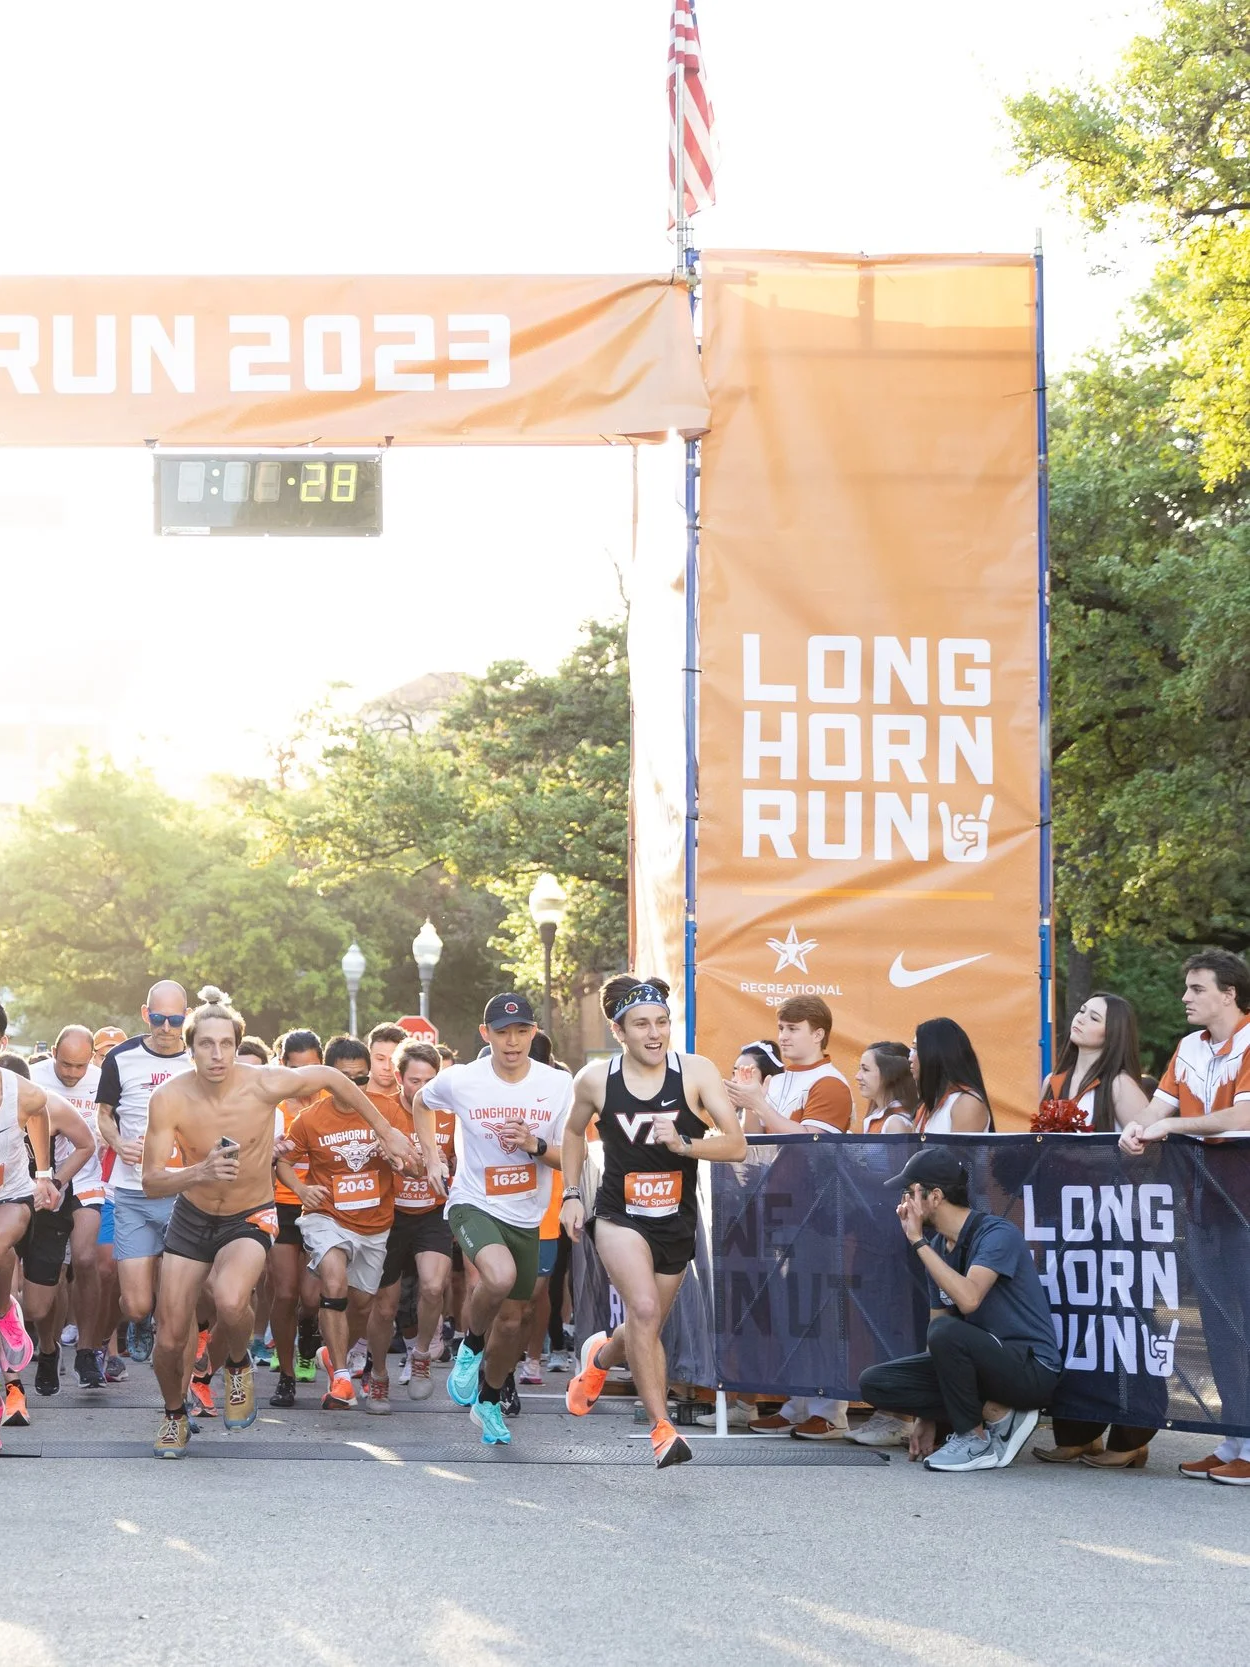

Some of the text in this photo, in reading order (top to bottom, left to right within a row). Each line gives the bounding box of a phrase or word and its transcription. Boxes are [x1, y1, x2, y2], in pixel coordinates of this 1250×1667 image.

[229, 313, 511, 392] 2023
[742, 633, 991, 707] LONG
[742, 711, 994, 784] HORN
[742, 789, 929, 861] RUN
[740, 983, 843, 995] RECREATIONAL
[469, 1107, 552, 1122] LONGHORN RUN
[318, 1129, 368, 1147] LONGHORN
[338, 1179, 375, 1194] 2043
[403, 1180, 428, 1192] 733
[492, 1172, 530, 1187] 1628
[633, 1181, 674, 1197] 1047
[631, 1196, 676, 1207] Tyler Speers
[1023, 1184, 1175, 1242] LONG
[1030, 1249, 1179, 1310] HORN
